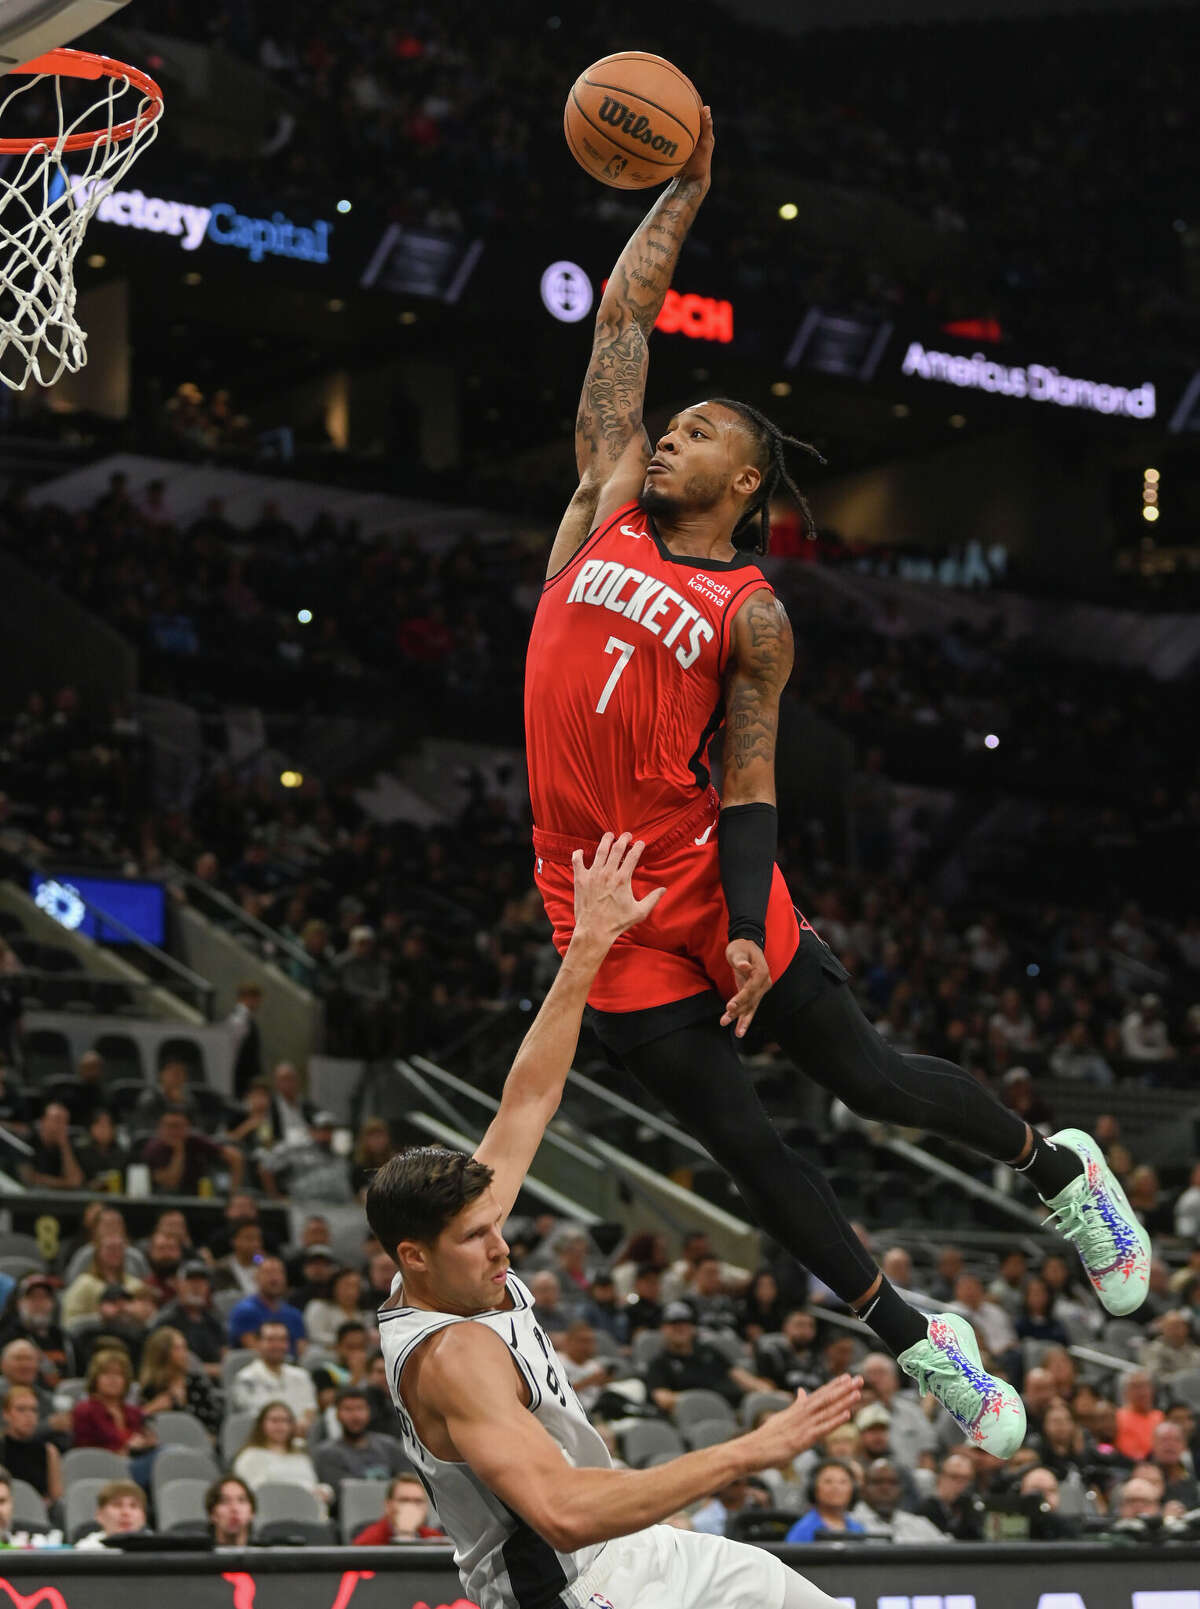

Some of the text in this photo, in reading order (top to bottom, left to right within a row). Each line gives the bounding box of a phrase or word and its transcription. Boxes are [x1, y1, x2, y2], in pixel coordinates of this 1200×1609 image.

[598, 95, 679, 158] Wilson
[566, 559, 714, 670] ROCKETS
[687, 577, 725, 608] karma
[696, 573, 731, 599] credit
[595, 636, 636, 714] 7
